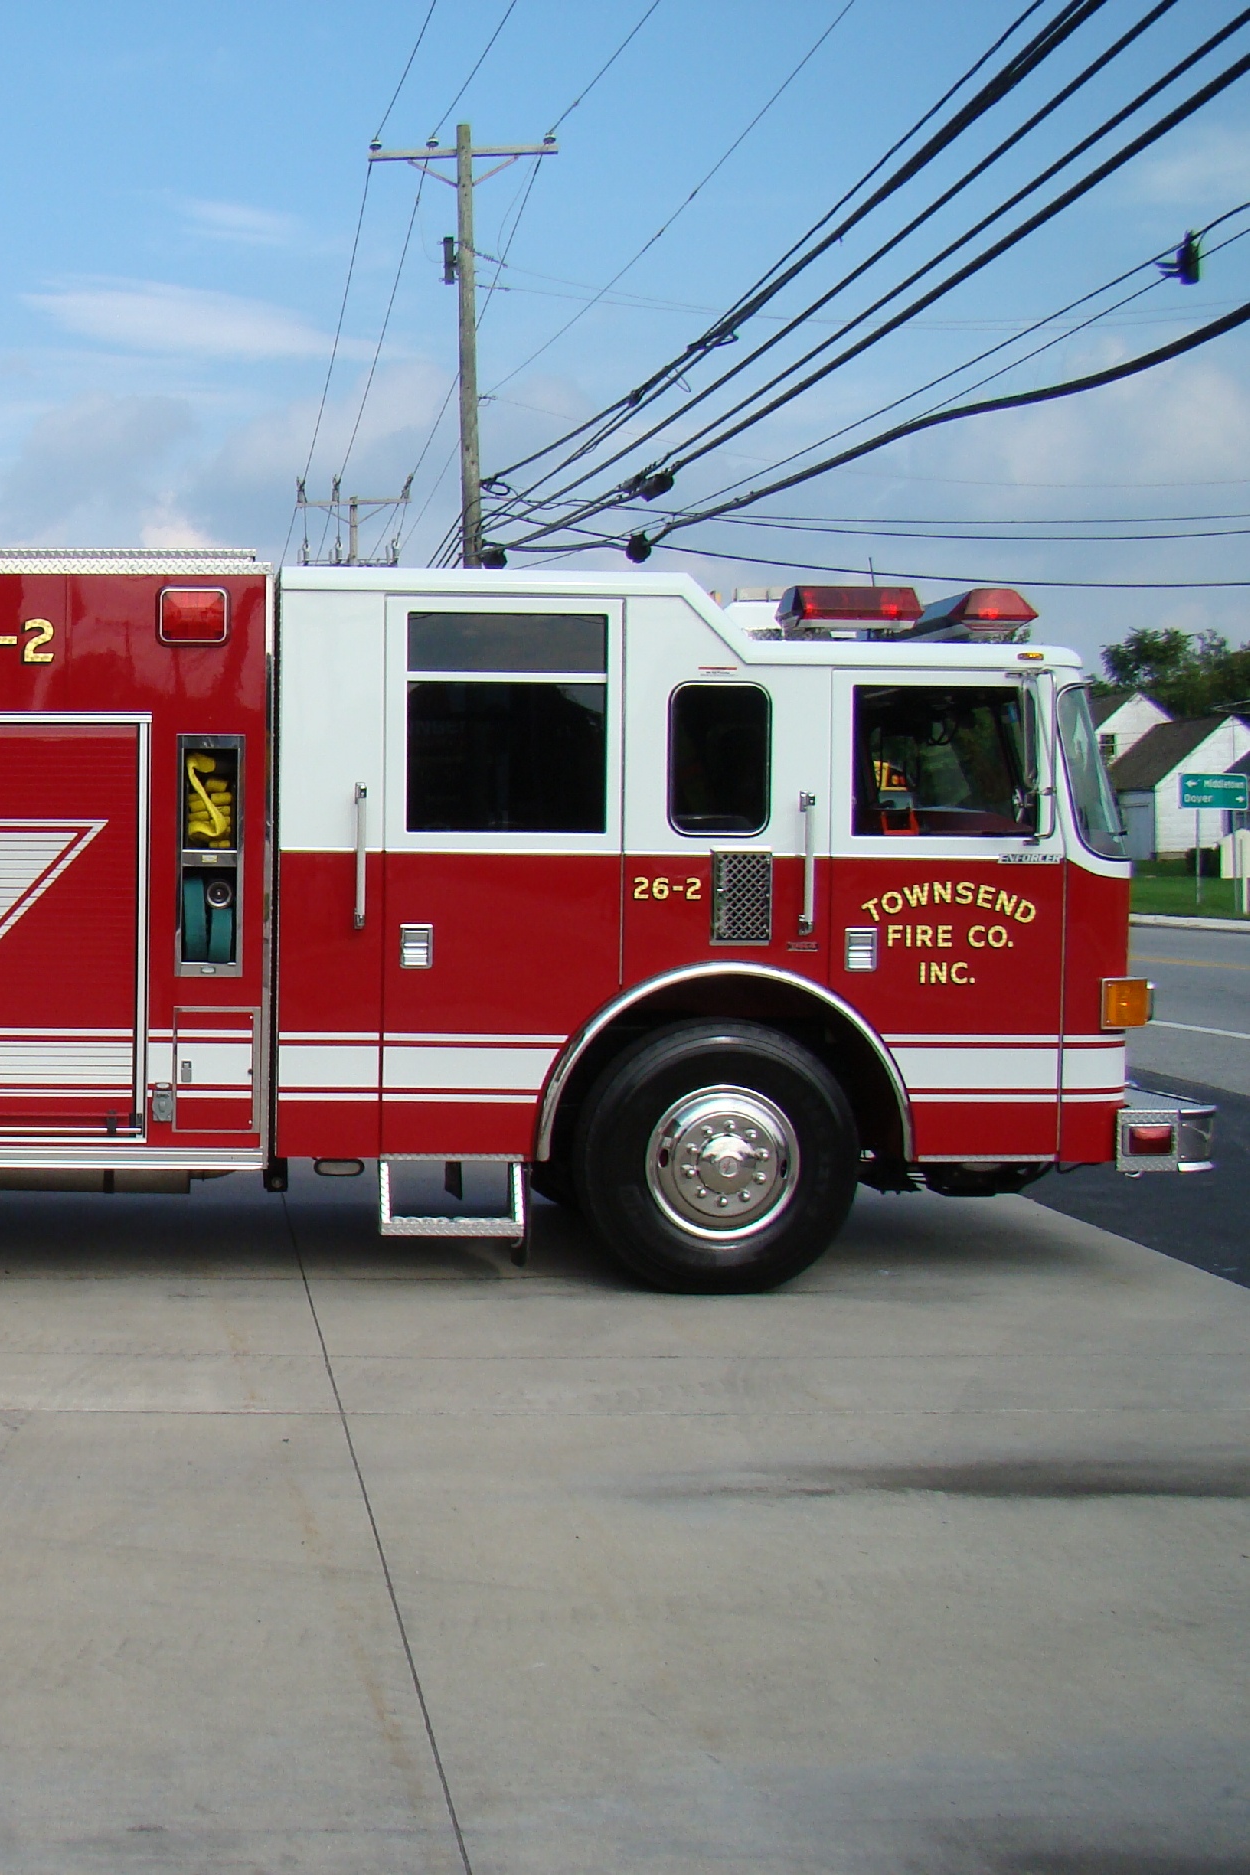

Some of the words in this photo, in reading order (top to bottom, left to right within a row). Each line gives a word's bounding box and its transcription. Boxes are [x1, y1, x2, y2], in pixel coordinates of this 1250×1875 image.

[1183, 793, 1213, 804] Dover
[1000, 853, 1061, 863] ENFORCER
[633, 876, 702, 900] 26-2
[861, 881, 1037, 924] TOWNSEND
[886, 924, 953, 948] FIRE
[967, 924, 1014, 948] CO.
[918, 962, 976, 985] INC.
